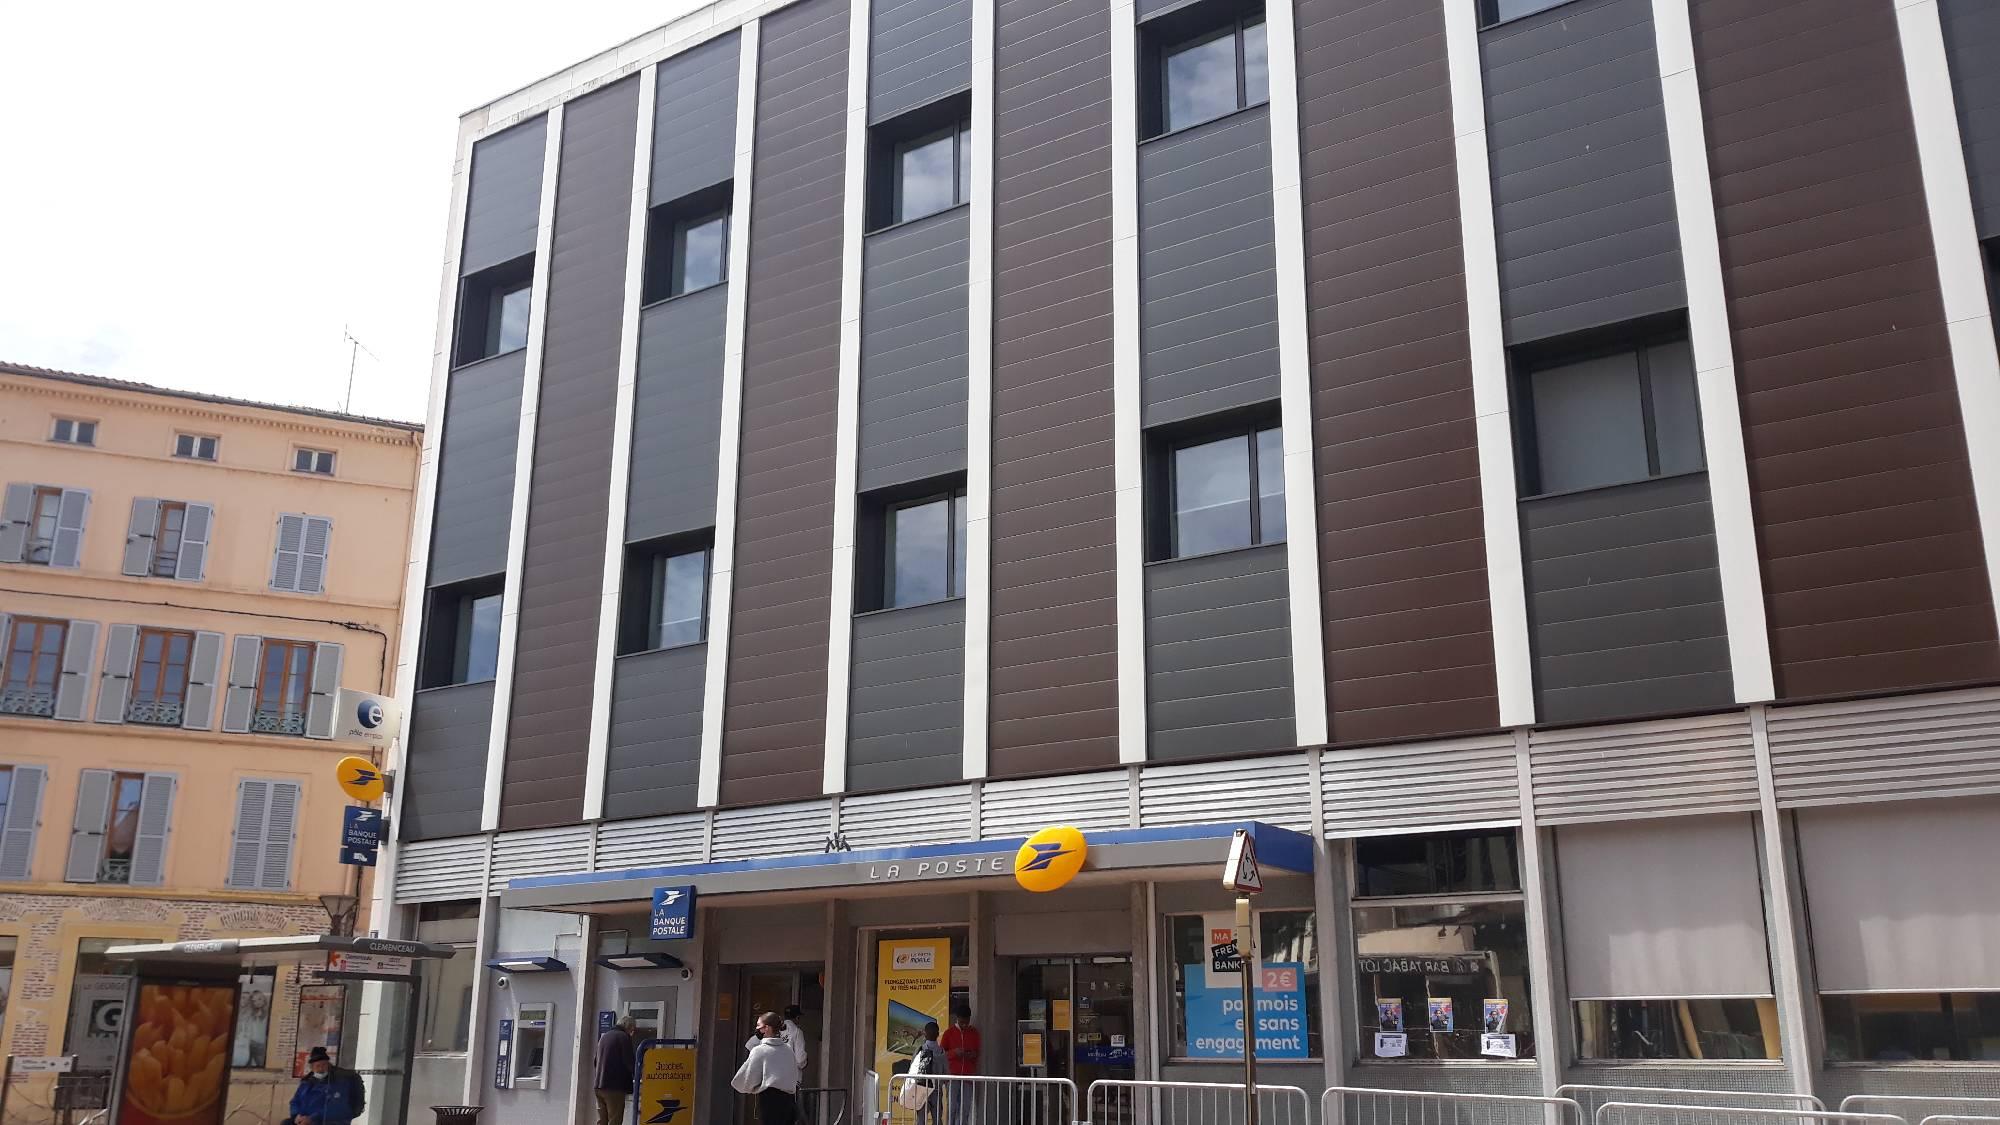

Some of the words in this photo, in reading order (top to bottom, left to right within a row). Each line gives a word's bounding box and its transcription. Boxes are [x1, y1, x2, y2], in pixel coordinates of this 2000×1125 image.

[348, 830, 377, 839] BANQUE
[347, 837, 377, 846] POSTALE
[870, 864, 901, 879] LA
[918, 857, 1005, 876] POSTE
[654, 908, 665, 917] LA
[653, 916, 686, 926] BANQUE
[652, 926, 685, 936] POSTALE
[1214, 932, 1229, 941] MA
[369, 942, 416, 953] CLEMENCEAU
[1215, 942, 1237, 958] FREN
[1214, 960, 1240, 970] BANK
[1267, 971, 1292, 988] 2€
[1223, 1000, 1244, 1015] pa
[1257, 995, 1298, 1011] mois
[1259, 1018, 1299, 1031] sans
[1196, 1035, 1301, 1053] engagment
